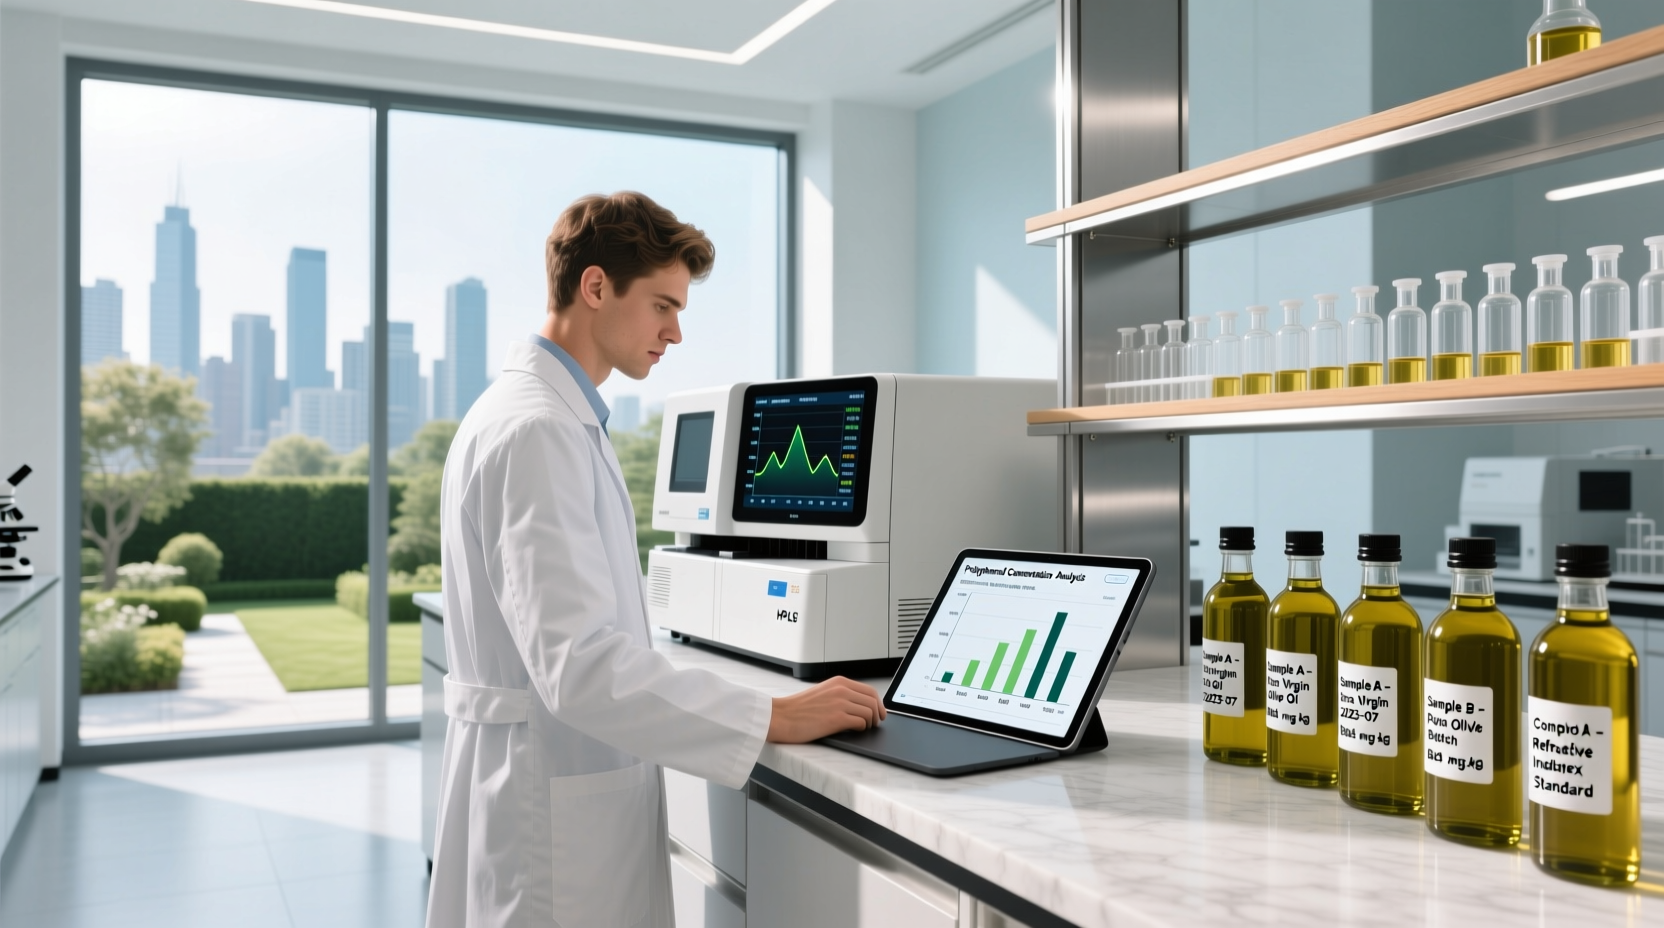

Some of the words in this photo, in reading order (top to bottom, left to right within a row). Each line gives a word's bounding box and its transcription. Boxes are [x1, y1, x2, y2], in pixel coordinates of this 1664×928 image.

[1224, 653, 1232, 664] A
[1296, 664, 1305, 676] A
[1373, 680, 1382, 691] A
[1465, 702, 1475, 714] B
[1581, 723, 1591, 737] A
